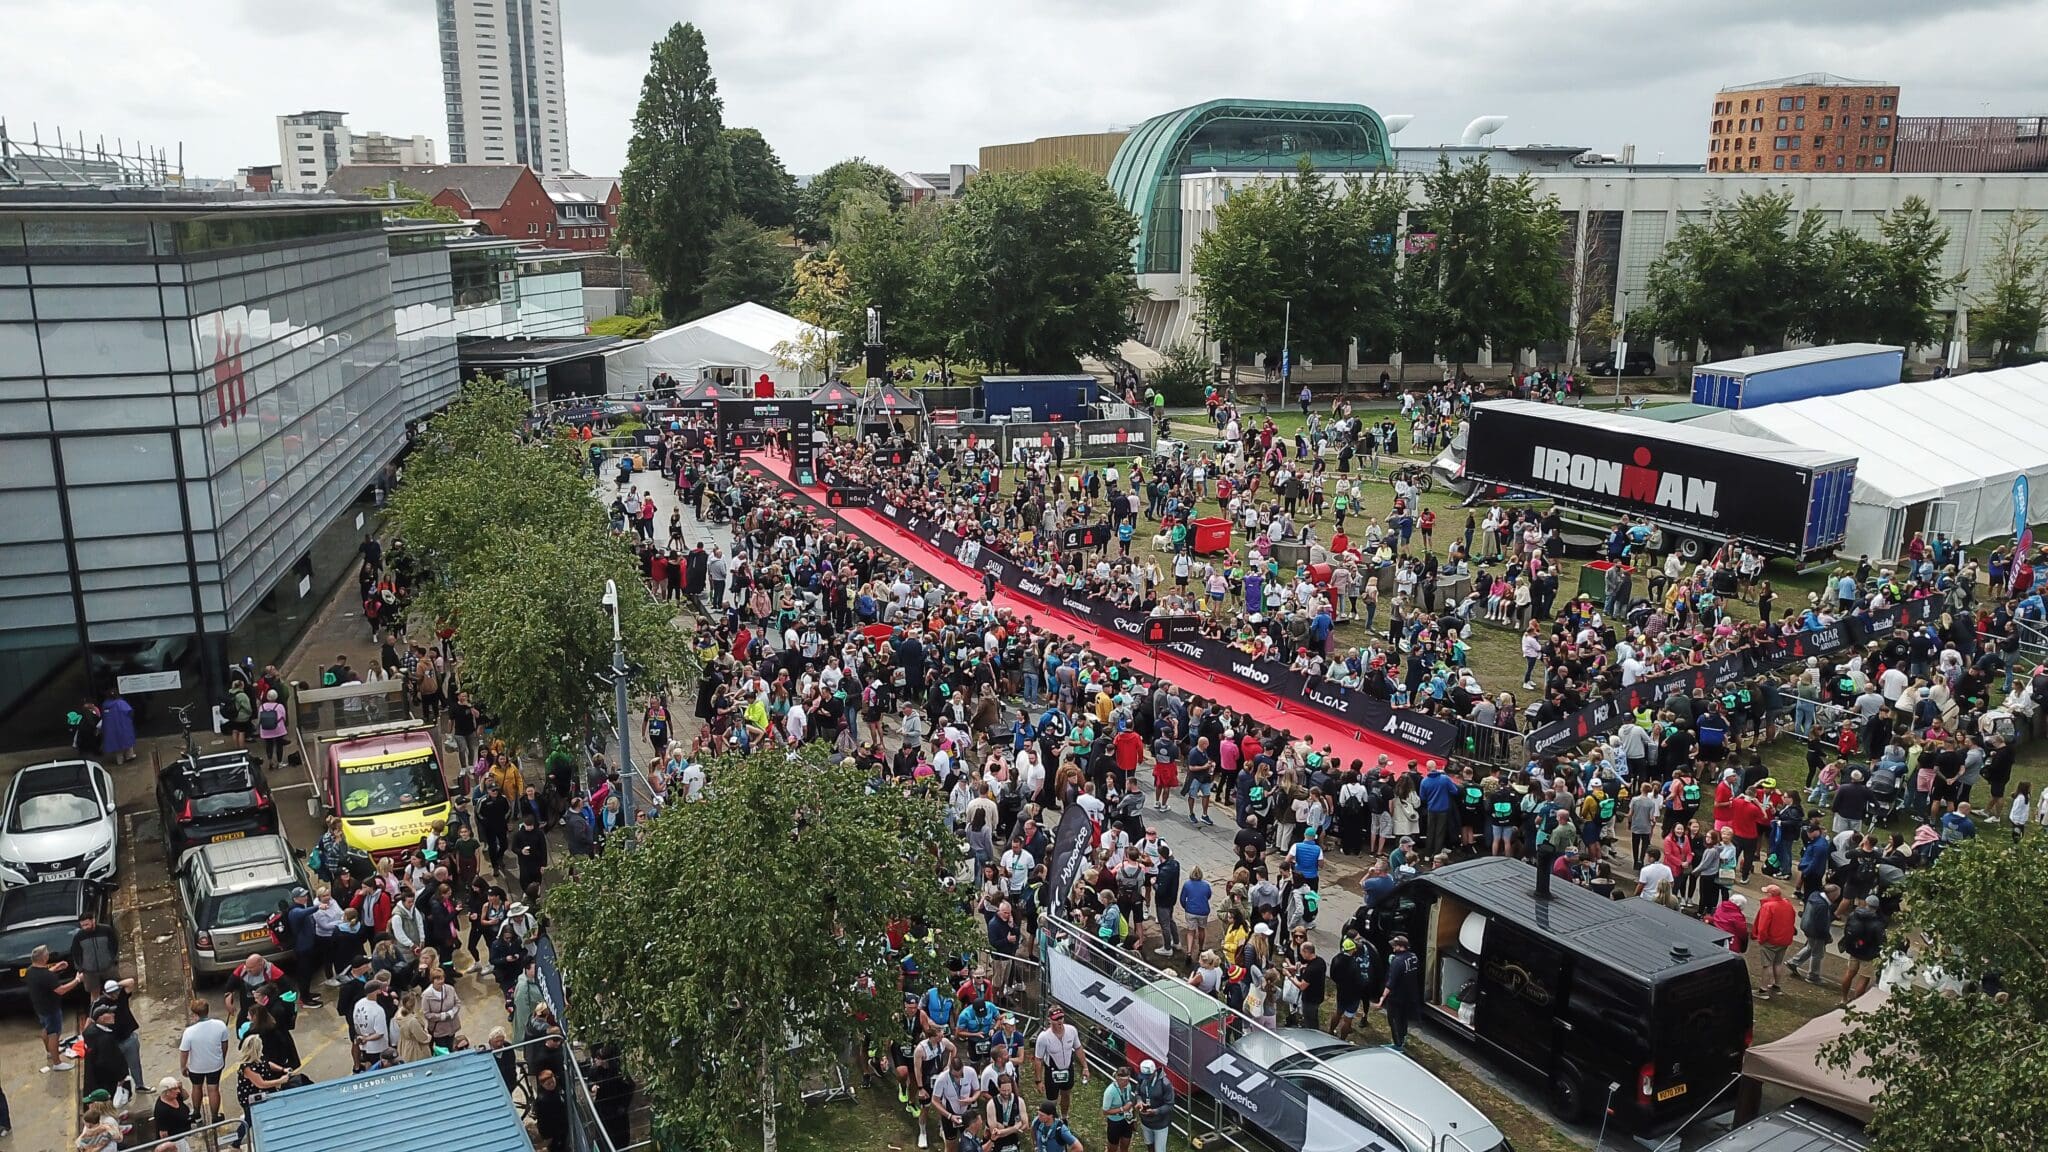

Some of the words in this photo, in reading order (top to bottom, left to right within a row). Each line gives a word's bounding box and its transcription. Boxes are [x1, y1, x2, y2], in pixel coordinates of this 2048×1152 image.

[1088, 428, 1145, 444] IRONMAN
[1532, 446, 1717, 518] IRONMAN
[1811, 628, 1839, 647] QATAR
[1232, 662, 1270, 684] wahoo
[1399, 720, 1433, 740] ATHLETIC
[345, 764, 381, 774] EVENT
[382, 756, 429, 770] SUPPORT
[1060, 826, 1088, 885] Hyperice
[1220, 1081, 1258, 1112] Hyperice
